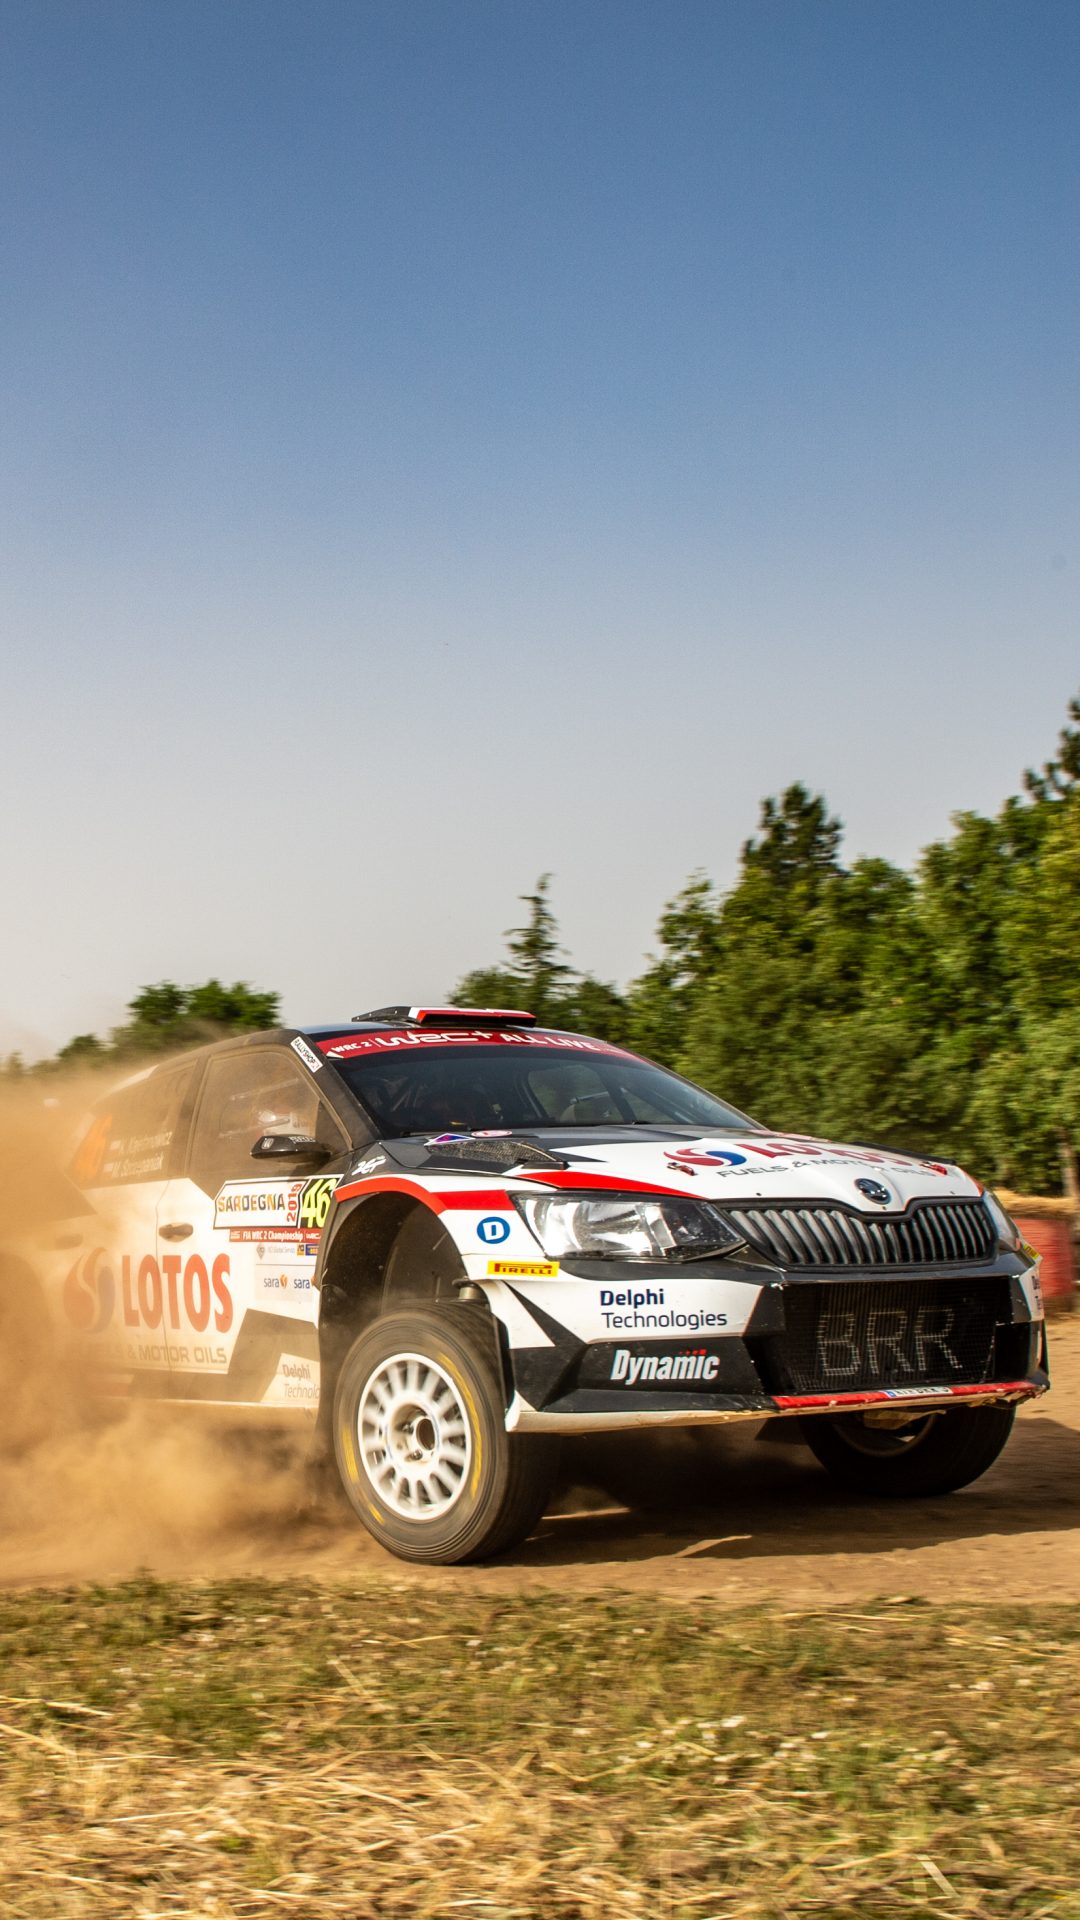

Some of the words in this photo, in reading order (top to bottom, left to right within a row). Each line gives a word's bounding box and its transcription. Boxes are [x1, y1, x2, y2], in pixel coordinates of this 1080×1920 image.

[331, 1042, 357, 1053] WRC
[361, 1041, 372, 1049] 2
[500, 1033, 548, 1045] ALL
[545, 1036, 601, 1051] LIVE
[734, 1142, 914, 1167] LOTOS
[716, 1164, 789, 1179] FUELS
[791, 1159, 808, 1169] &
[217, 1193, 287, 1213] SARDEGNA
[286, 1183, 303, 1223] 2019
[301, 1178, 337, 1229] 46
[242, 1230, 251, 1240] FIA
[252, 1230, 263, 1240] WRC
[268, 1230, 303, 1242] Championship
[482, 1221, 505, 1241] D
[494, 1262, 553, 1275] PIRELLI
[263, 1277, 280, 1288] sara
[293, 1278, 311, 1289] sara
[121, 1252, 234, 1334] LOTOS
[600, 1289, 664, 1309] Delphi
[601, 1310, 728, 1331] Technologies
[816, 1305, 963, 1377] BRR
[138, 1344, 190, 1362] MOTOR
[193, 1346, 228, 1364] OILS
[282, 1364, 311, 1381] Delphi
[610, 1348, 720, 1386] Dynamic
